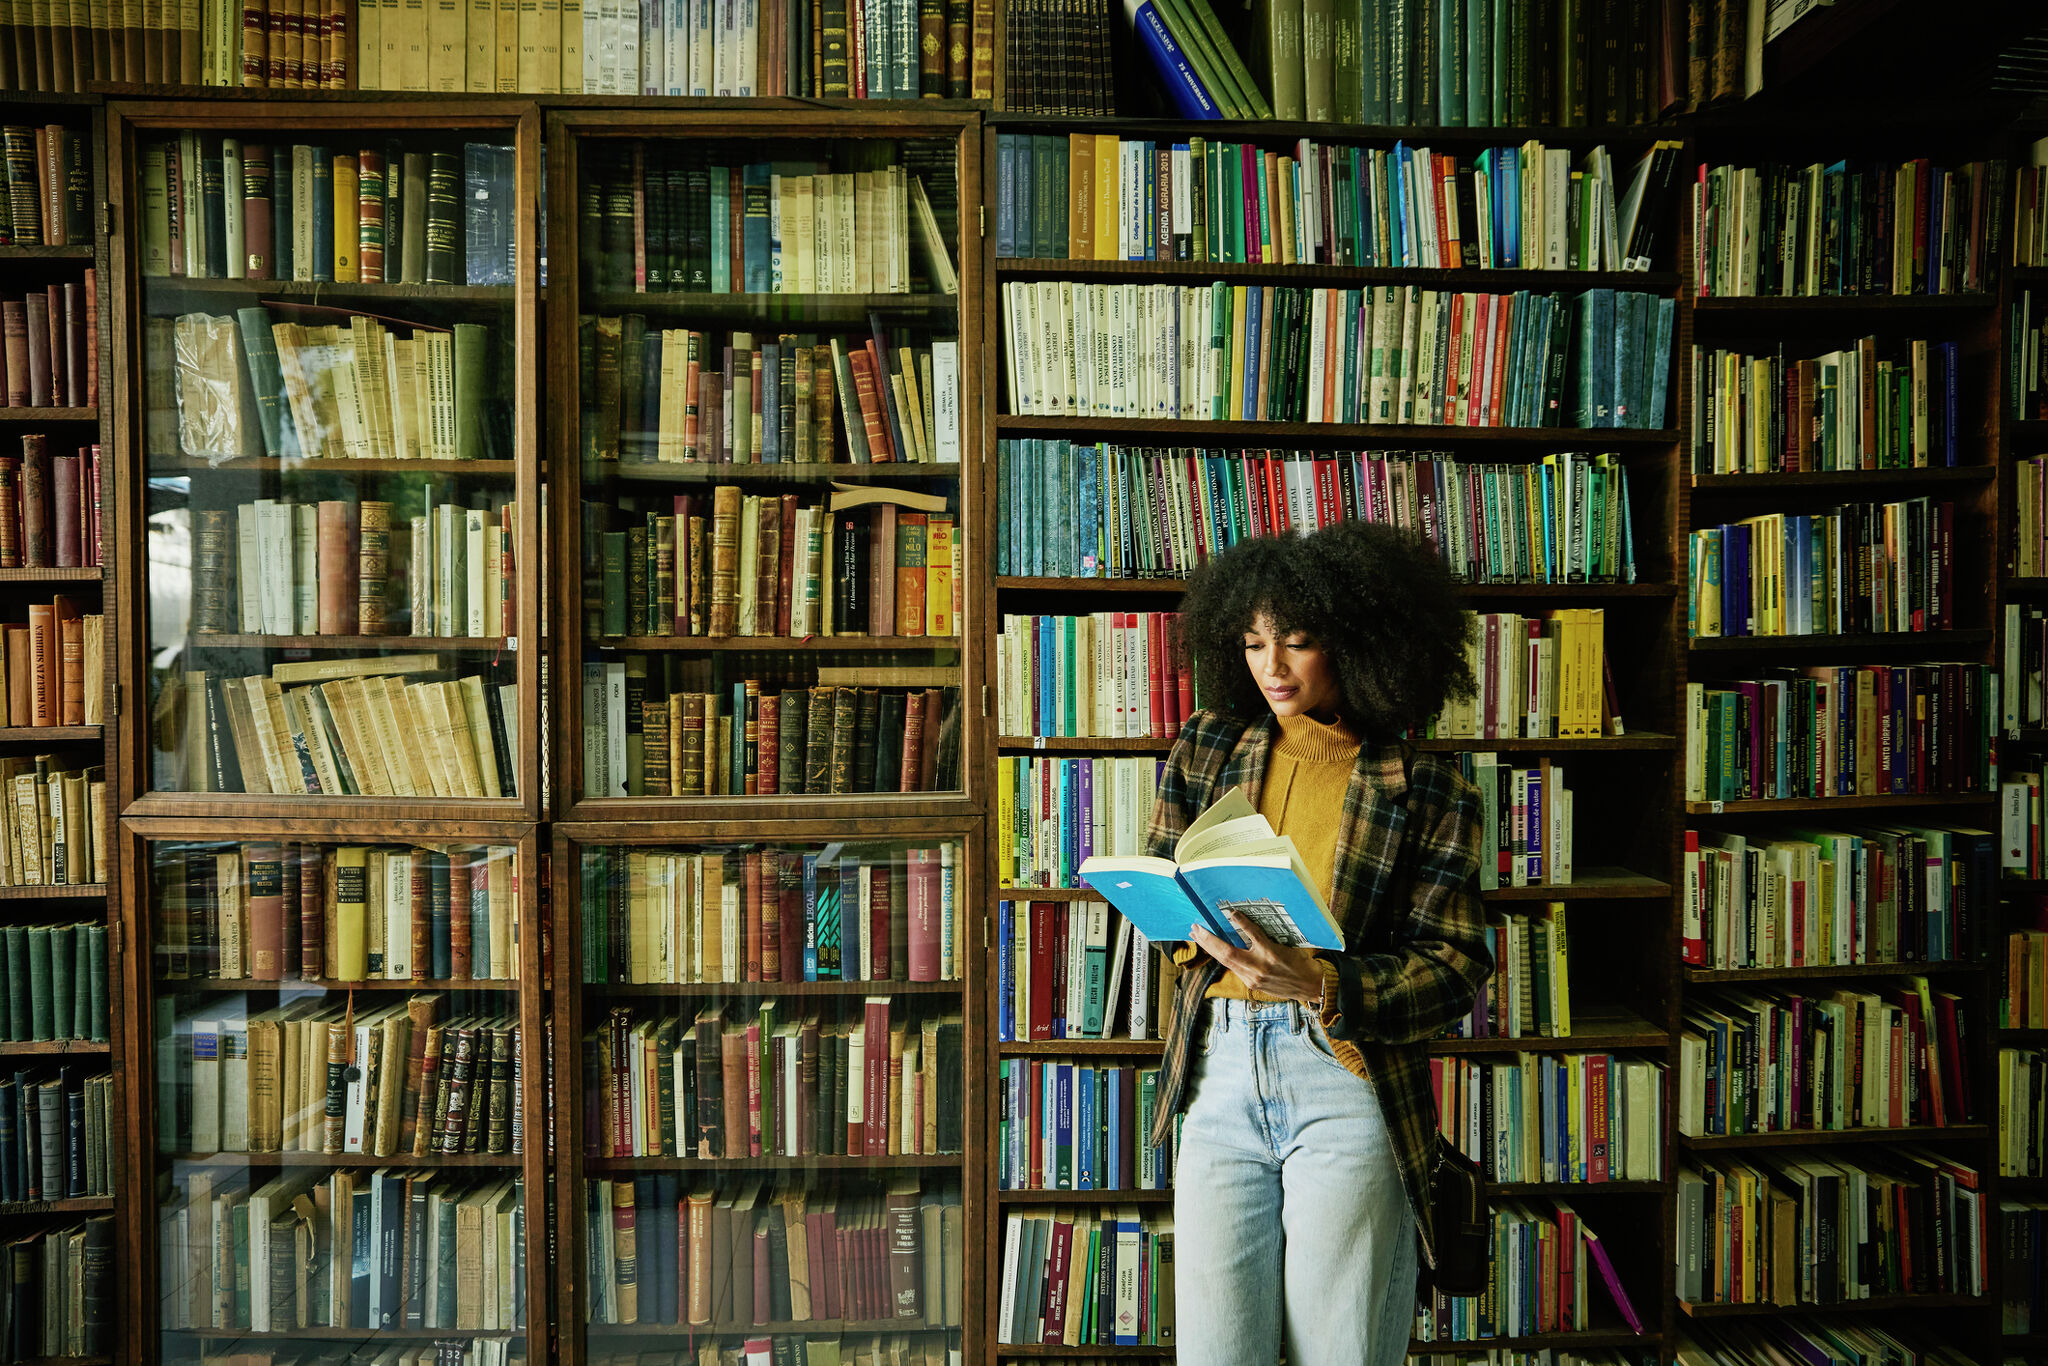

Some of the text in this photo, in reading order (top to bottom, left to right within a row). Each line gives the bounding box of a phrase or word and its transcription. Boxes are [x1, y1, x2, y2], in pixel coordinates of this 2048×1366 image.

[1146, 11, 1175, 52] EXCELSIOR
[1183, 70, 1210, 111] ANIVERSARIO
[49, 148, 54, 156] TO
[167, 171, 177, 192] BAD
[168, 194, 178, 240] YANKEE
[1148, 472, 1161, 553] INVERSIÓN EXTRANJERA
[1220, 499, 1228, 527] PÚBLICO
[1423, 494, 1432, 538] ARBITRAJE
[906, 543, 921, 551] NILO
[1931, 597, 1939, 615] ZETAS
[510, 638, 515, 649] 2
[35, 625, 46, 718] EIN KREUZ IN SIBIRIEN
[1117, 695, 1122, 703] LA
[1131, 692, 1136, 700] LA
[1881, 715, 1891, 770] MANTO PÚRPURA
[1533, 808, 1539, 816] de
[1714, 803, 1722, 813] 5
[806, 891, 815, 948] Medicina LEGAL
[1821, 1253, 1826, 1262] EN
